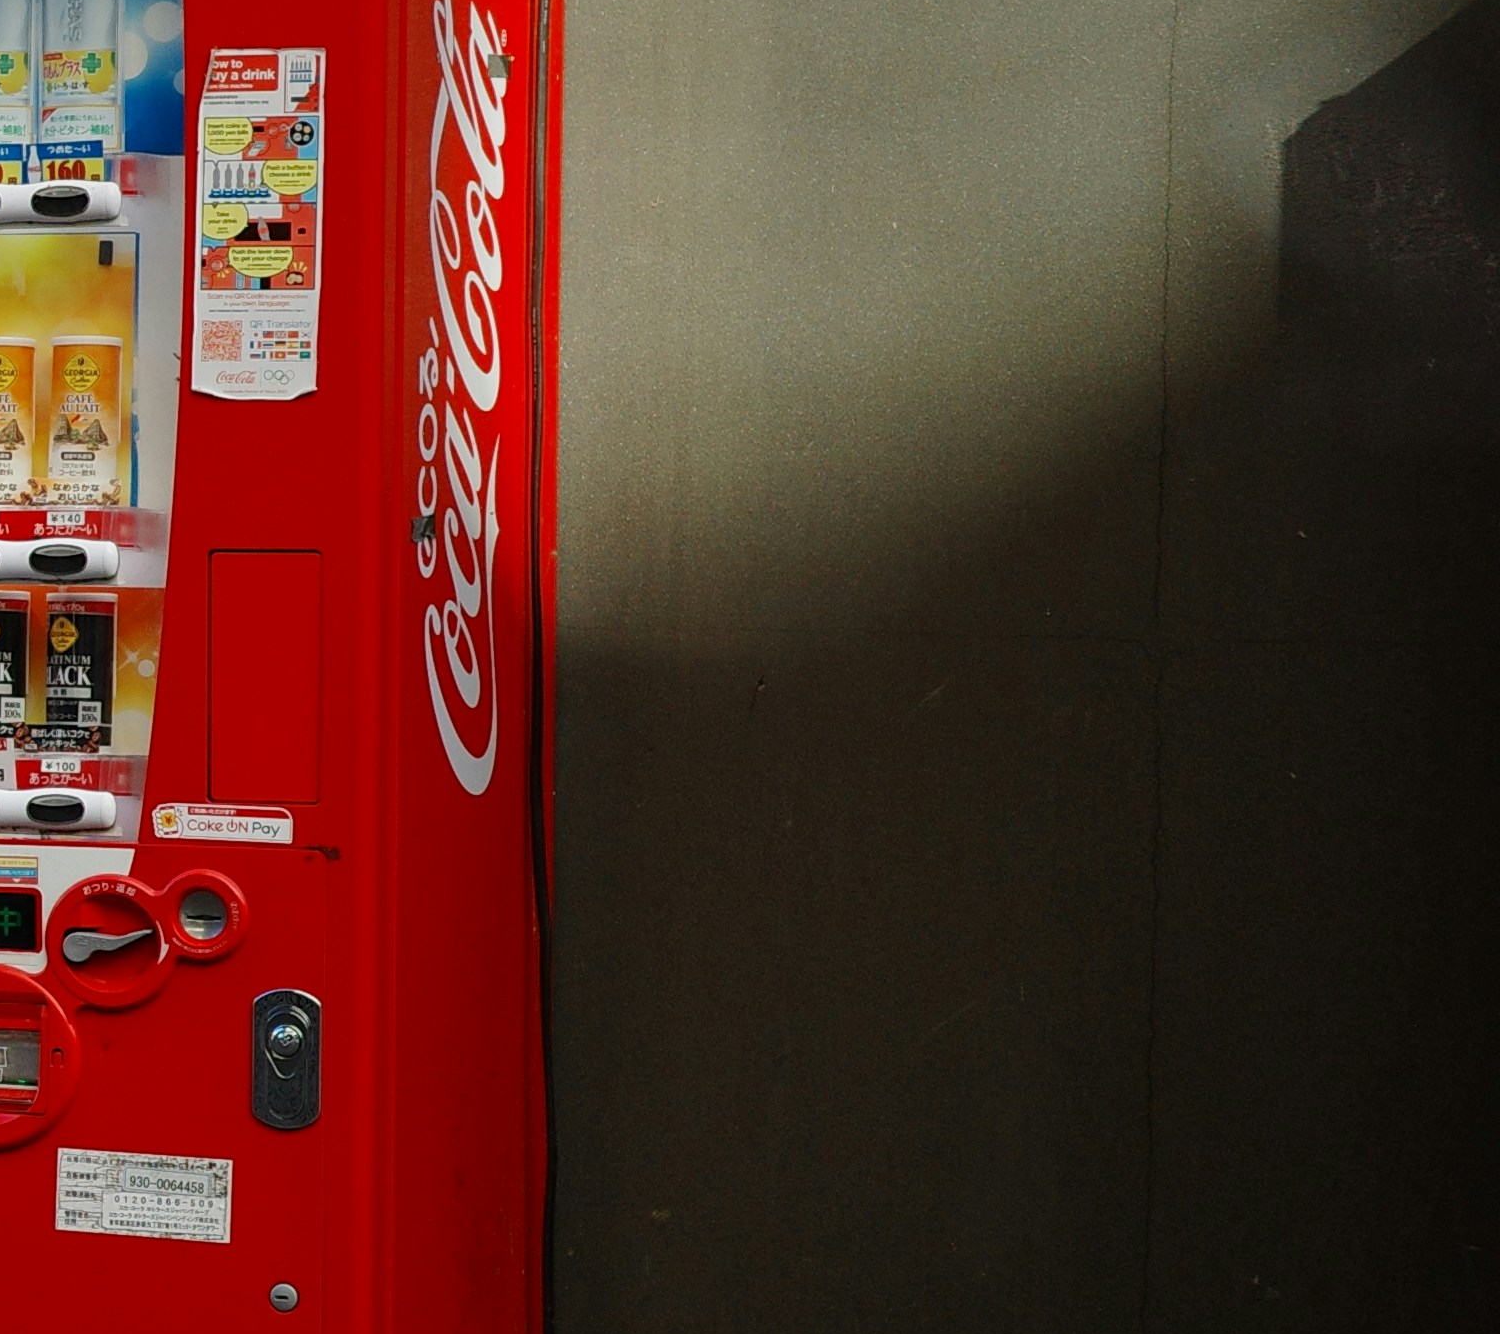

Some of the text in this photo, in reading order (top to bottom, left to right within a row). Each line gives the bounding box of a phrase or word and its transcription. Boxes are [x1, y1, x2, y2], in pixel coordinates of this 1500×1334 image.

[232, 59, 243, 67] to
[242, 69, 275, 80] drink
[51, 513, 80, 523] ¥140
[46, 761, 76, 772] ¥100
[187, 818, 223, 832] Coke
[252, 822, 281, 837] Pay
[130, 1175, 204, 1193] 930-0064458
